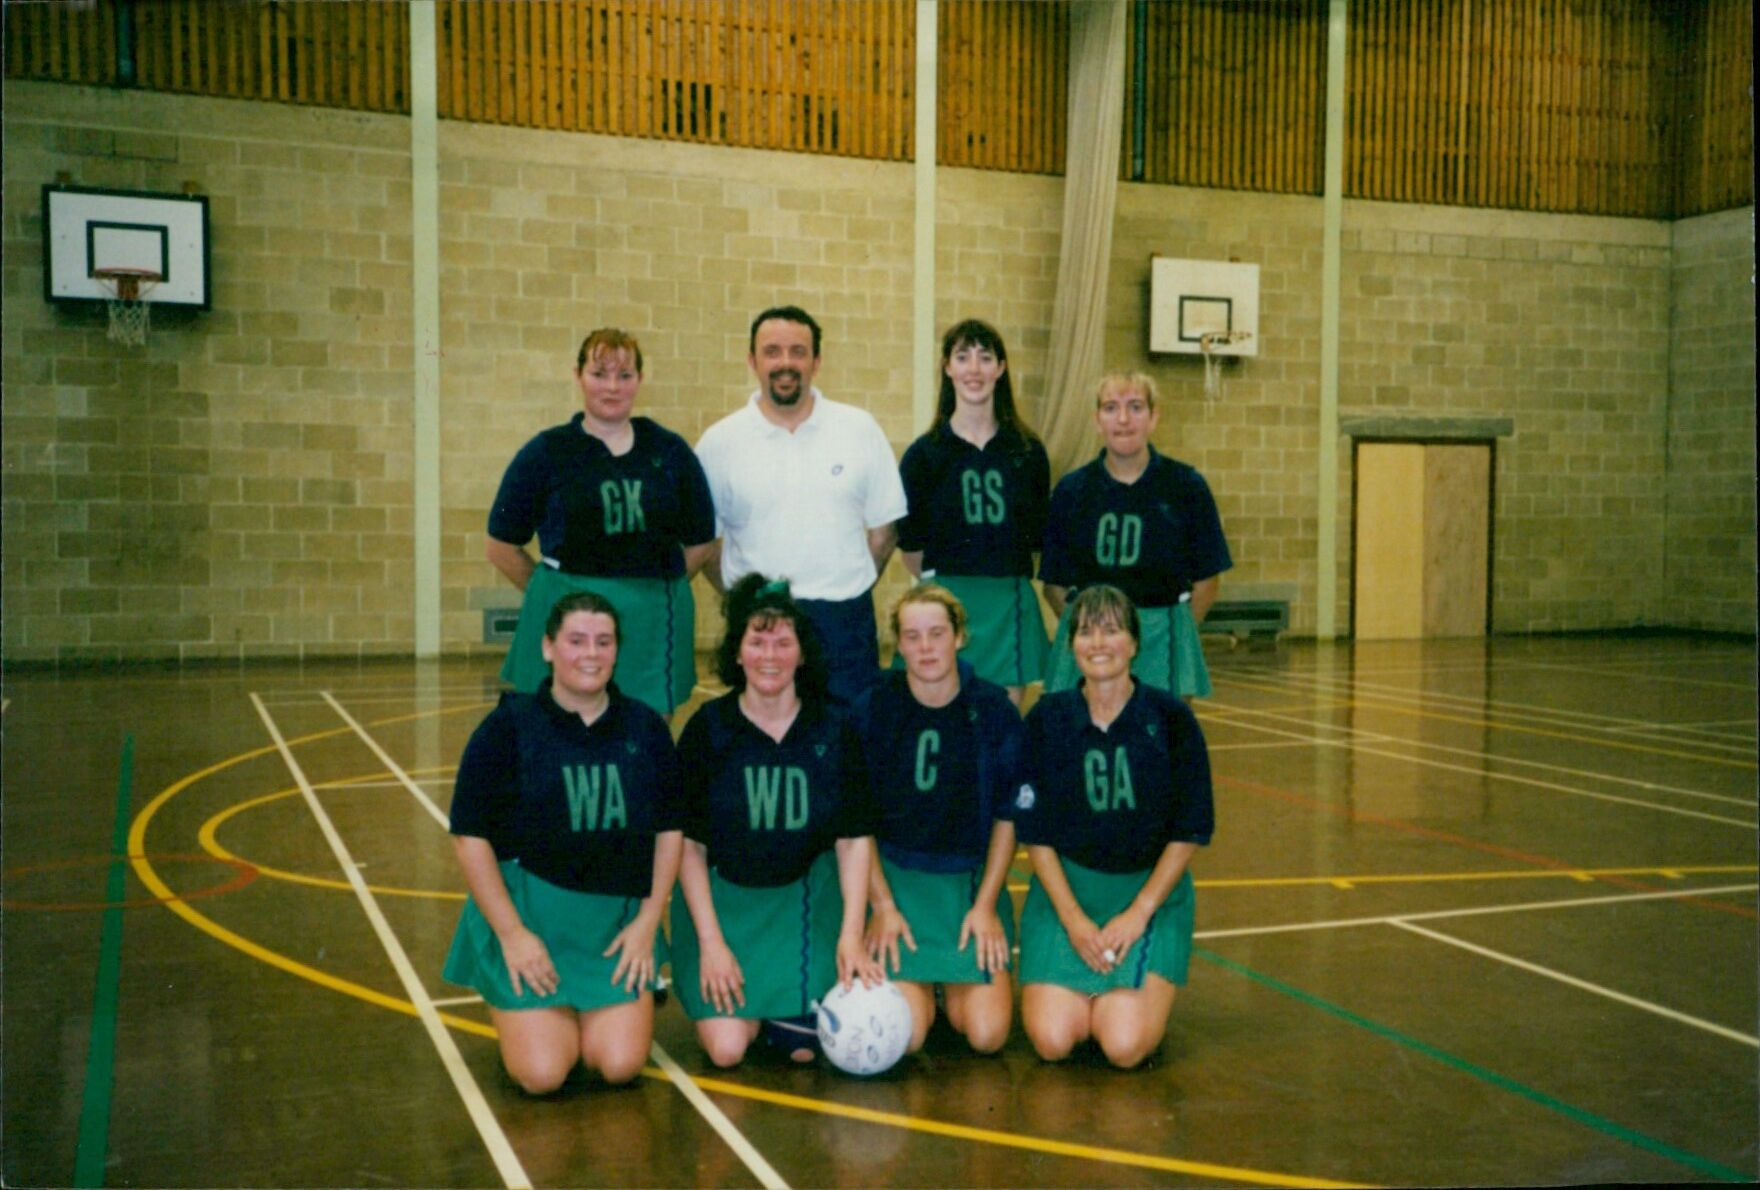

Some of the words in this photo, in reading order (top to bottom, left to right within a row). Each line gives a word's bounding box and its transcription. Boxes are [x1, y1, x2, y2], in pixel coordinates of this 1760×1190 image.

[599, 478, 646, 535] GK
[961, 468, 1006, 525] GS
[1095, 511, 1143, 567] GD
[914, 729, 941, 793] C
[1083, 745, 1137, 812] GA
[561, 763, 627, 832] WA
[743, 765, 810, 831] WD
